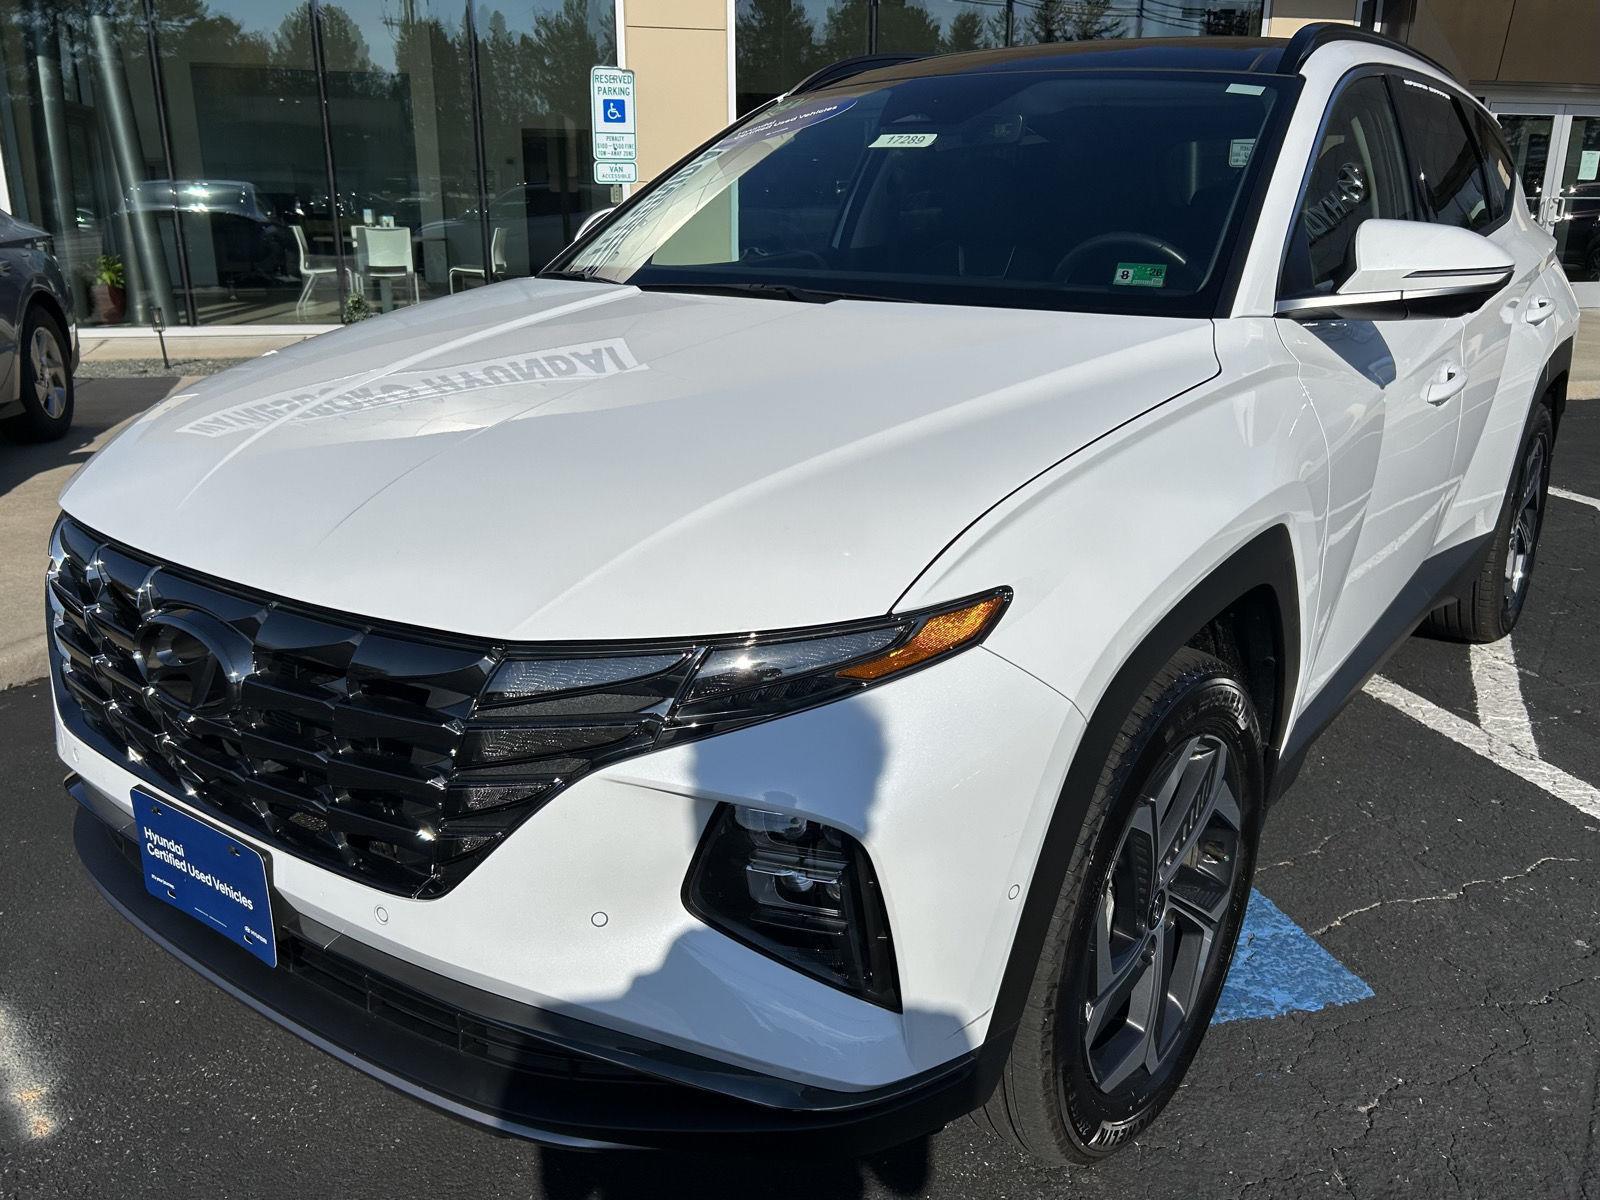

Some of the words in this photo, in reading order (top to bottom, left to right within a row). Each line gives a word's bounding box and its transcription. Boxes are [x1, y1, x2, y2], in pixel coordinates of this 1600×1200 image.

[594, 74, 633, 84] RESERVED
[597, 86, 631, 96] PARKING
[799, 105, 838, 119] Vehicles
[886, 135, 926, 145] 17289
[1121, 270, 1130, 280] 8
[144, 826, 185, 857] Hyundai
[147, 843, 187, 872] Certified
[188, 862, 212, 886] Used
[212, 876, 254, 910] Vehicles
